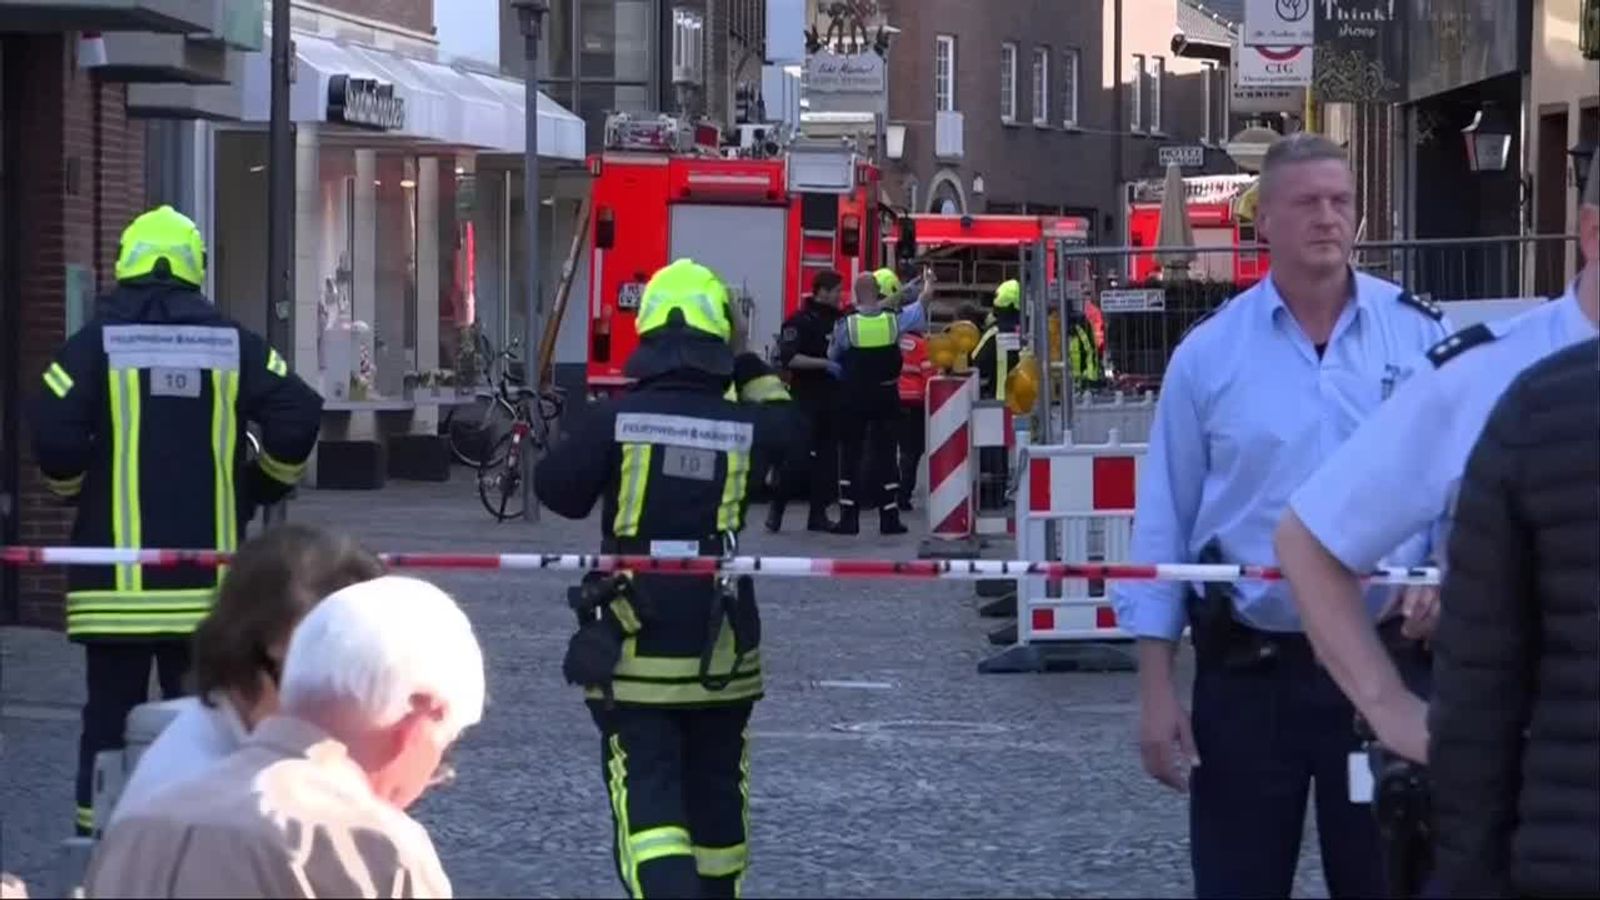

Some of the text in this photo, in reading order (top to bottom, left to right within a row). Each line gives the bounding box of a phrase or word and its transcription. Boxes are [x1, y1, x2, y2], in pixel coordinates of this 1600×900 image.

[1321, 0, 1395, 21] Think!
[1338, 24, 1376, 38] shoes
[165, 373, 187, 389] 10
[680, 454, 701, 472] 10
